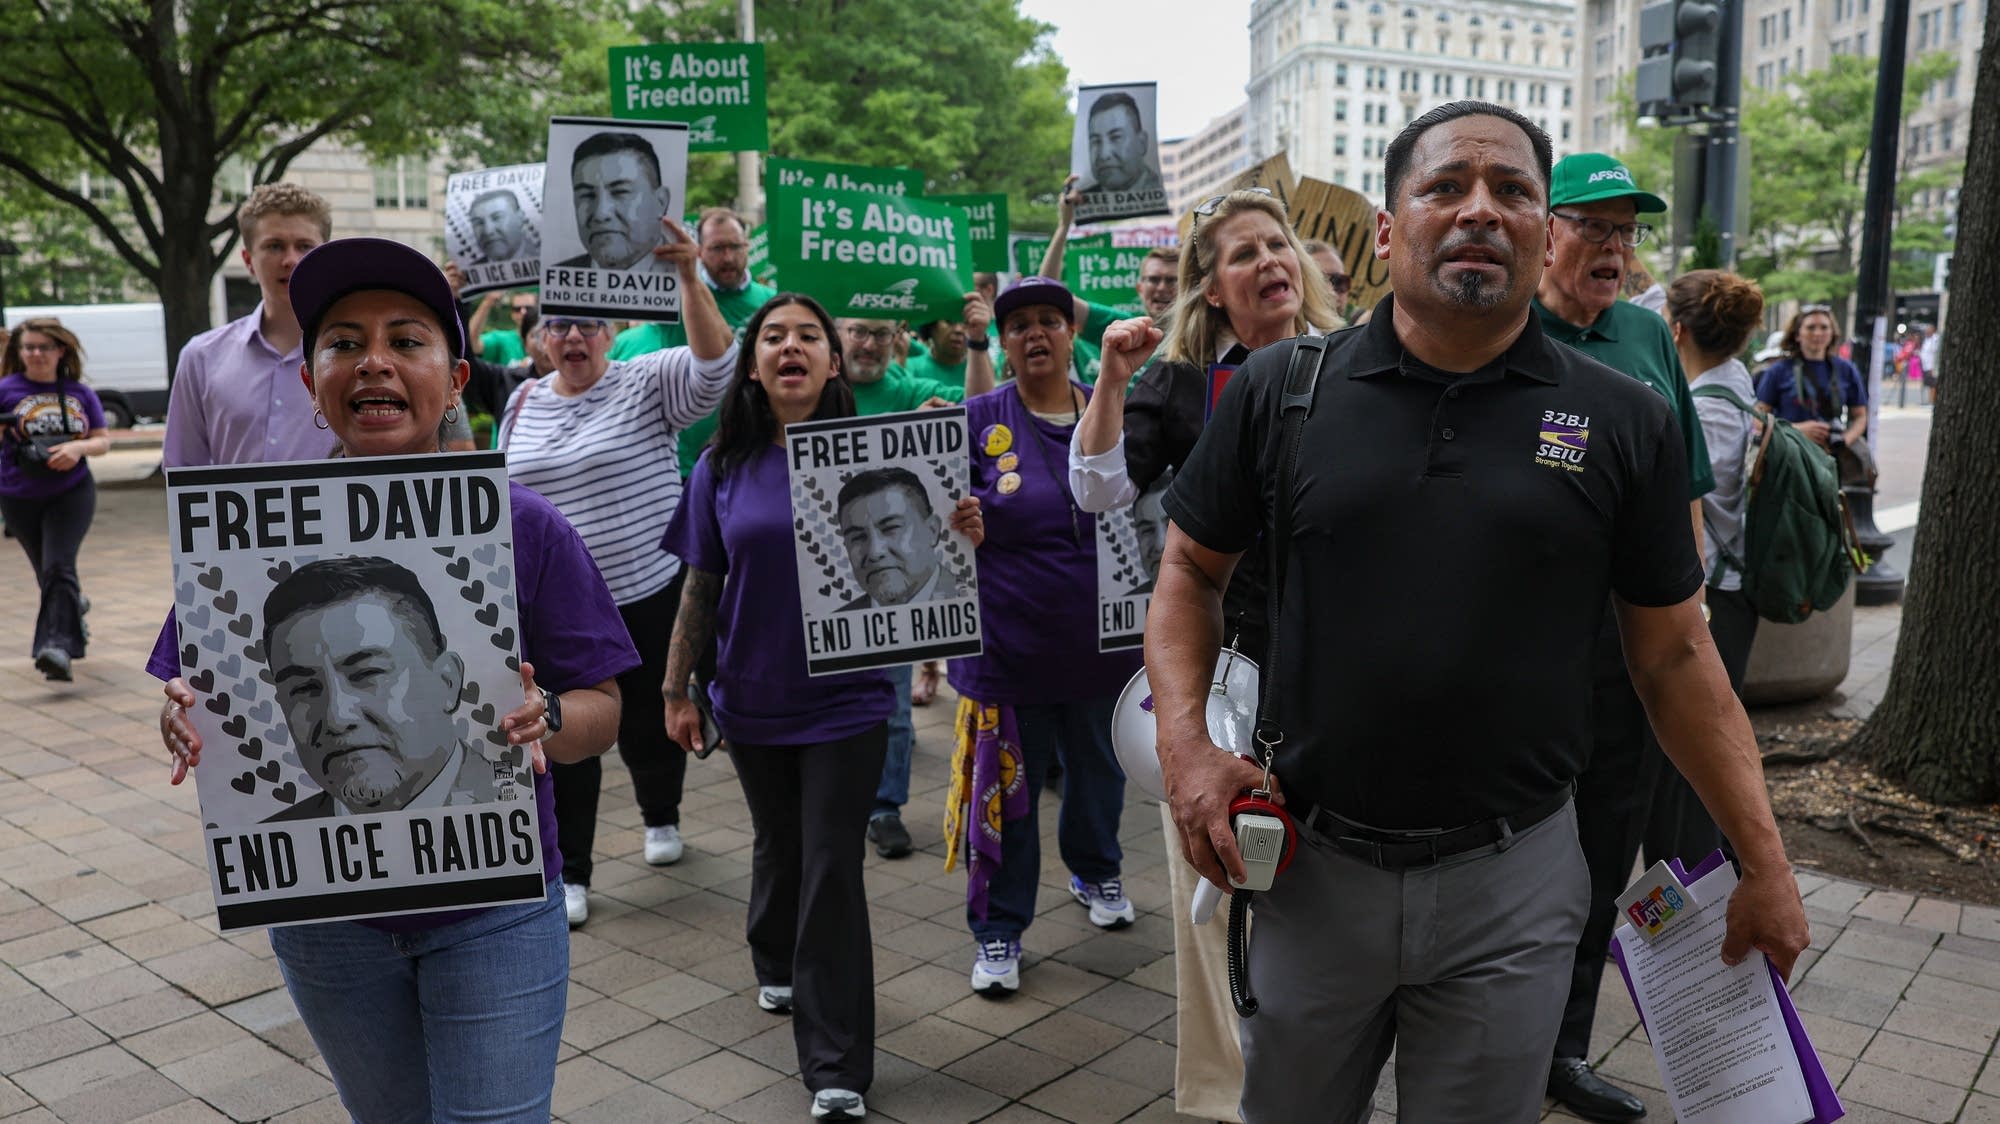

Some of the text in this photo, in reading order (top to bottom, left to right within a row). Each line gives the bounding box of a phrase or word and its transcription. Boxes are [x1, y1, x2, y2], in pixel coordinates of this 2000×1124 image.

[625, 53, 749, 81] It's About
[626, 80, 750, 110] Freedom!
[451, 168, 541, 192] FREE DAVID
[1083, 191, 1164, 205] REE DAVID
[802, 198, 853, 229] It's
[862, 203, 955, 241] About
[802, 230, 957, 270] Freedom!
[486, 264, 506, 282] ICE
[511, 259, 541, 278] RAID
[1078, 254, 1110, 272] It's
[546, 270, 676, 292] FREE DAVID
[1080, 272, 1140, 291] Freed
[546, 290, 676, 306] END ICE RAIDS NOW
[1542, 410, 1590, 428] 32BJ
[792, 430, 869, 471] FREE
[882, 420, 963, 460] DAVID
[1536, 444, 1586, 463] SEIU
[1535, 456, 1585, 473] Stronger Together
[178, 476, 500, 553] FREE DAVID
[808, 601, 977, 655] END ICE RAIDS
[1102, 600, 1135, 633] END
[213, 809, 535, 895] END ICE RAIDS
